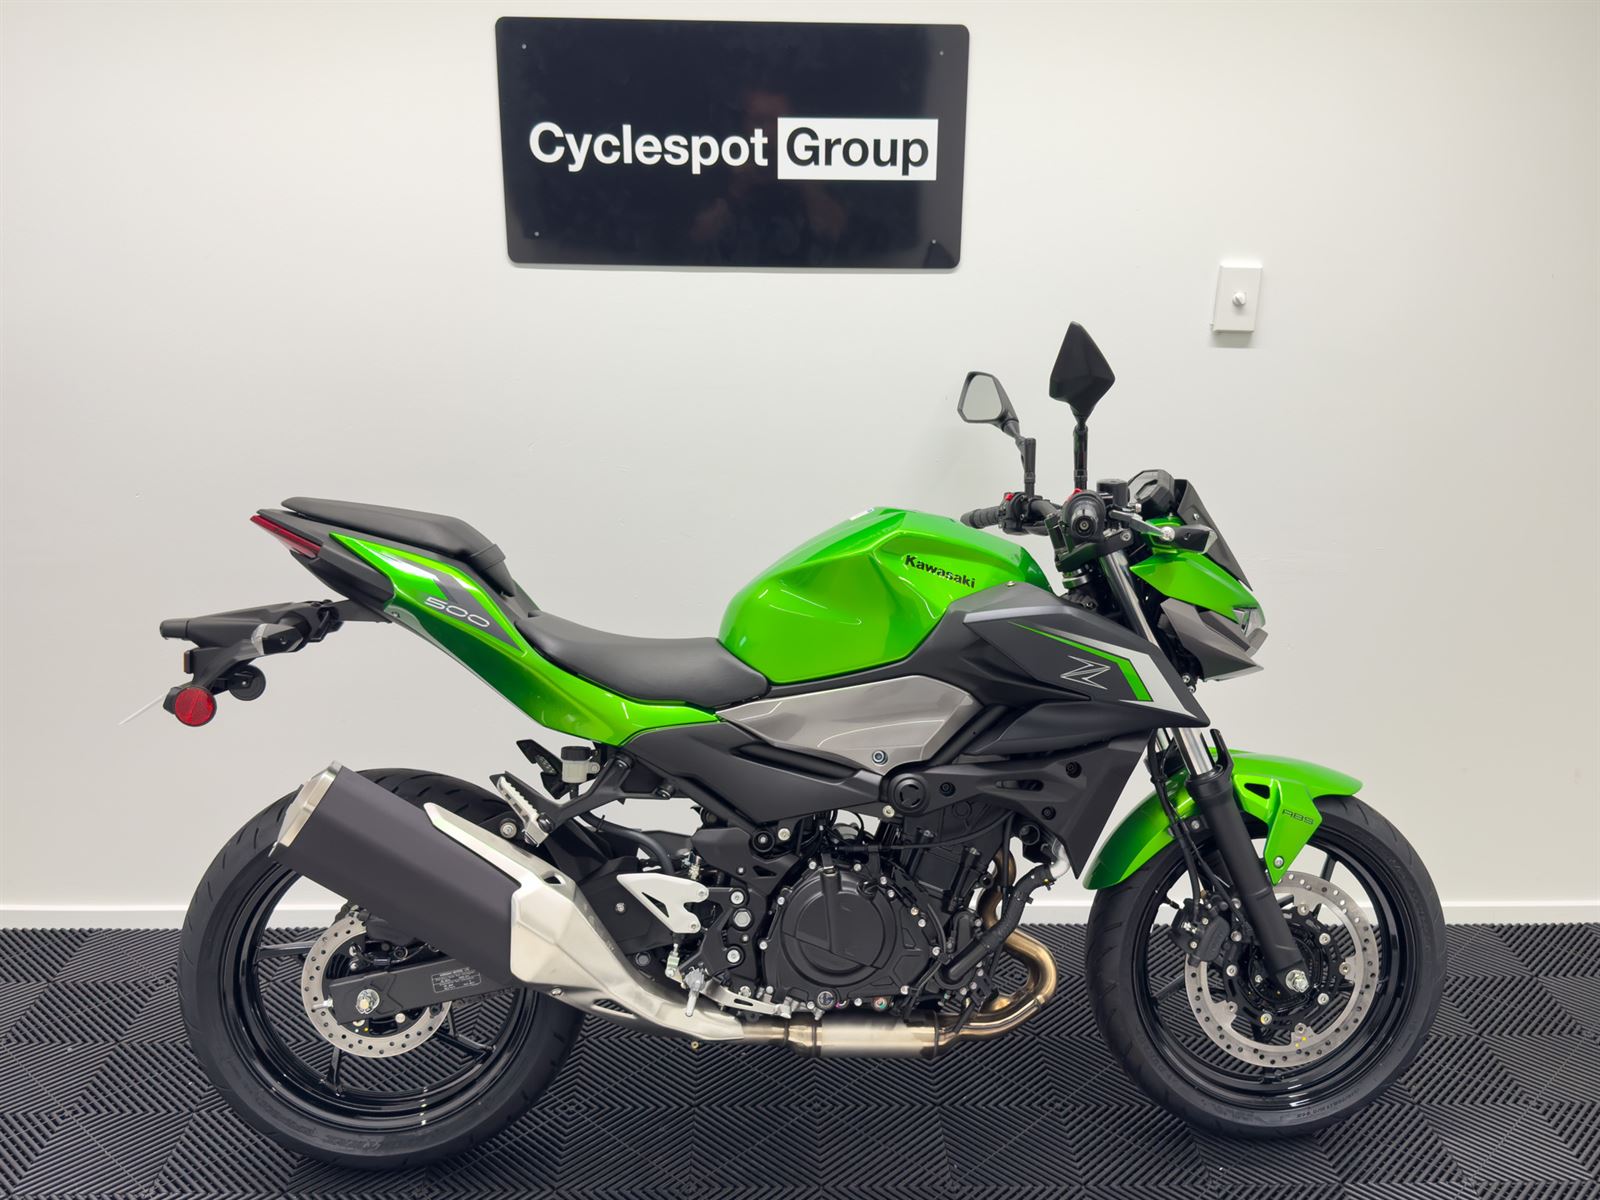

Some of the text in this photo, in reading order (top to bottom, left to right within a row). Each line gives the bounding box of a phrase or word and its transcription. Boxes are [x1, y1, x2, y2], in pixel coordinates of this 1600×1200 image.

[528, 121, 930, 177] Cyclespot Group
[904, 555, 976, 589] Kawasaki
[424, 596, 490, 628] 500
[1060, 655, 1112, 691] Z
[1282, 809, 1314, 825] ABS
